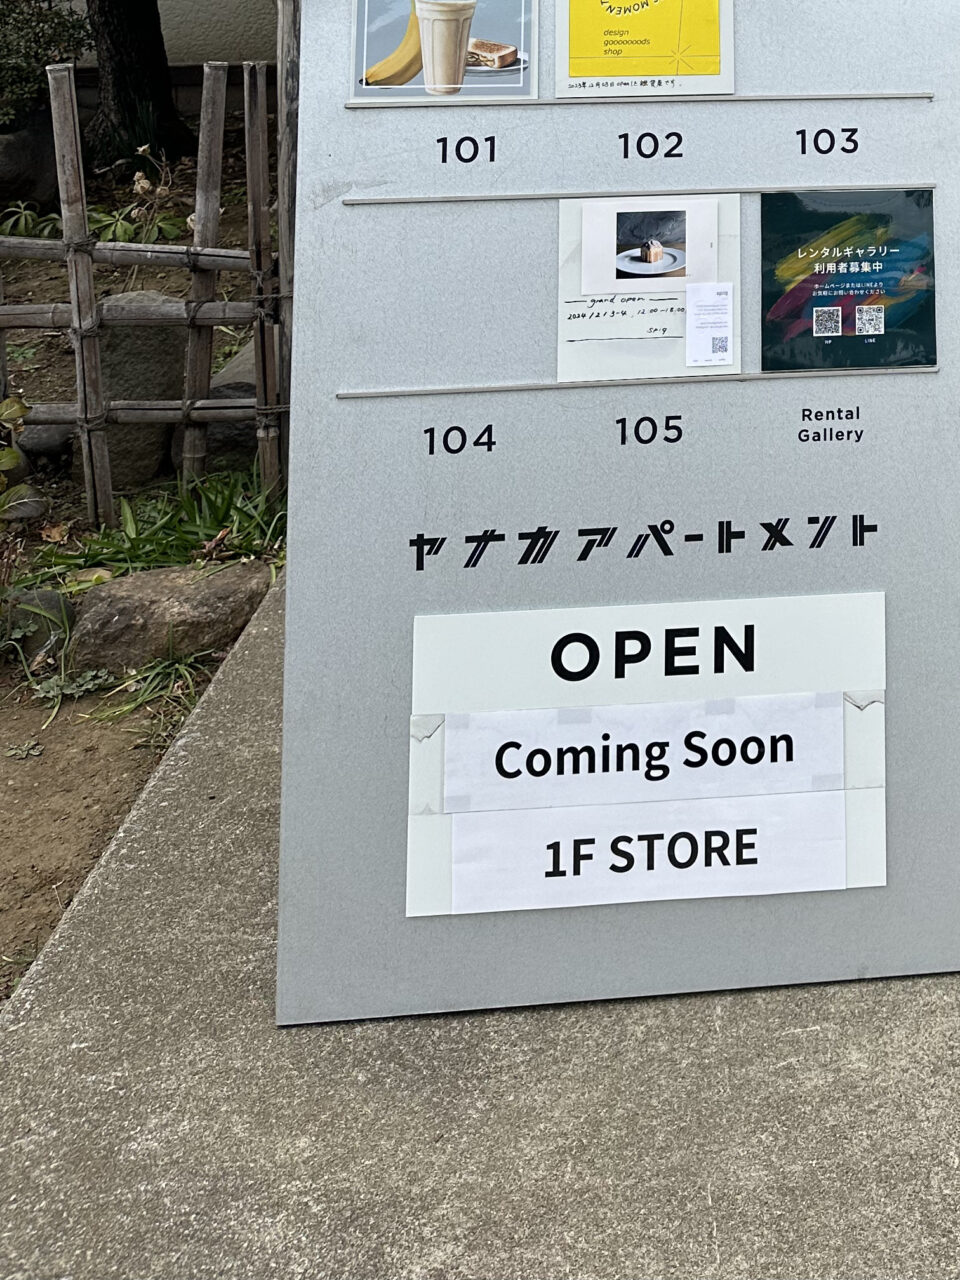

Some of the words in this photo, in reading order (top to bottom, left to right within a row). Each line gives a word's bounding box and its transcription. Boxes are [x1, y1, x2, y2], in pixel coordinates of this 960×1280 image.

[603, 29, 630, 37] design
[603, 47, 623, 56] shop
[436, 135, 496, 164] 101
[618, 131, 683, 159] 102
[795, 127, 859, 155] 103
[797, 245, 900, 259] レンタルギャラリー
[813, 261, 883, 274] 利用者募集中
[587, 295, 617, 308] grand
[620, 297, 646, 305] open
[801, 406, 861, 422] Rental
[423, 424, 497, 456] 104
[615, 415, 683, 446] 105
[797, 427, 864, 443] Gallery
[409, 514, 878, 572] ヤナカアパートメント
[550, 624, 755, 682] OPEN
[495, 732, 670, 782] Coming
[682, 730, 795, 769] Soon
[544, 837, 596, 878] 1F
[608, 828, 759, 874] STORE
